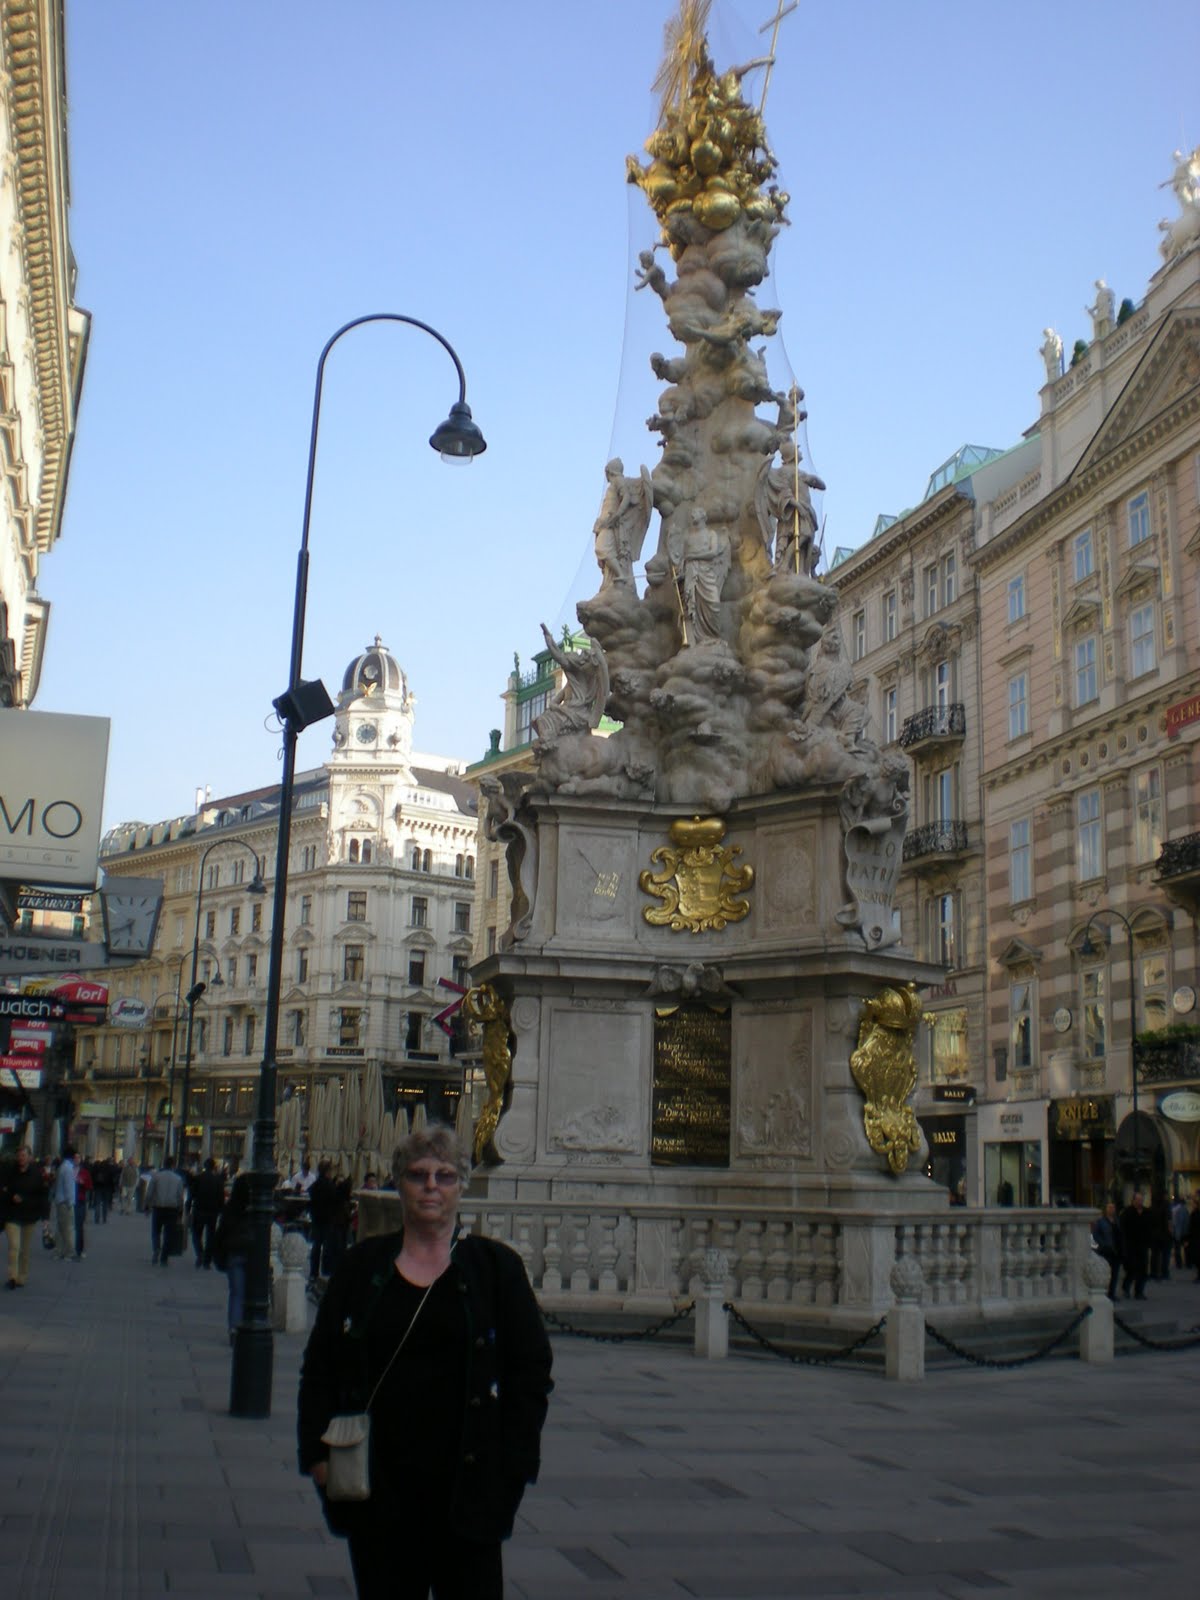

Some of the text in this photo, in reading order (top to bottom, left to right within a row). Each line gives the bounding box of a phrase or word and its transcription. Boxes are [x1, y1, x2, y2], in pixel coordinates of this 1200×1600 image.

[2, 1057, 33, 1068] Triumph
[943, 1089, 966, 1099] BALLY
[1059, 1103, 1099, 1121] KNIZE
[932, 1131, 957, 1144] BALLY
